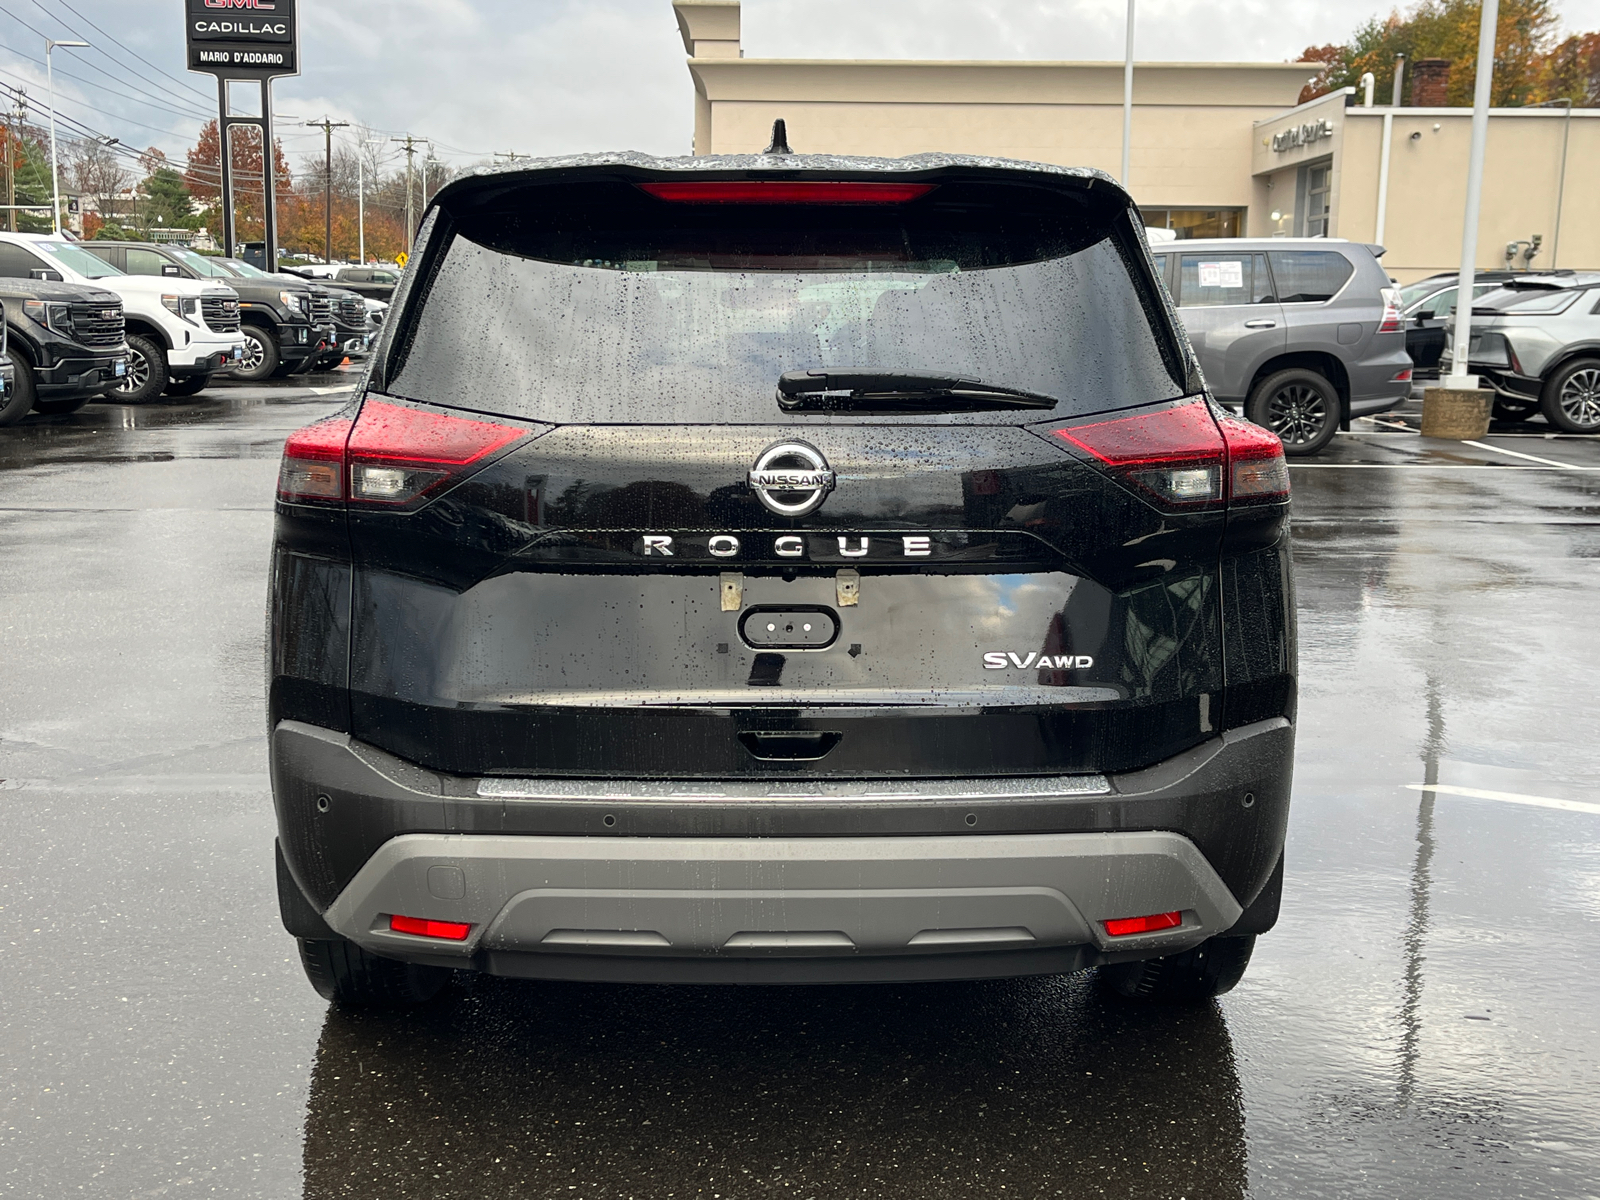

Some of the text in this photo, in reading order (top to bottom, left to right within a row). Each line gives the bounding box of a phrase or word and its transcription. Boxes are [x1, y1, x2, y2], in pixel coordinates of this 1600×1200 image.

[195, 21, 286, 34] CADILLAC
[200, 51, 283, 64] MARIO D'ADDARIO
[759, 475, 824, 485] NISSAN
[643, 535, 932, 557] ROGUE
